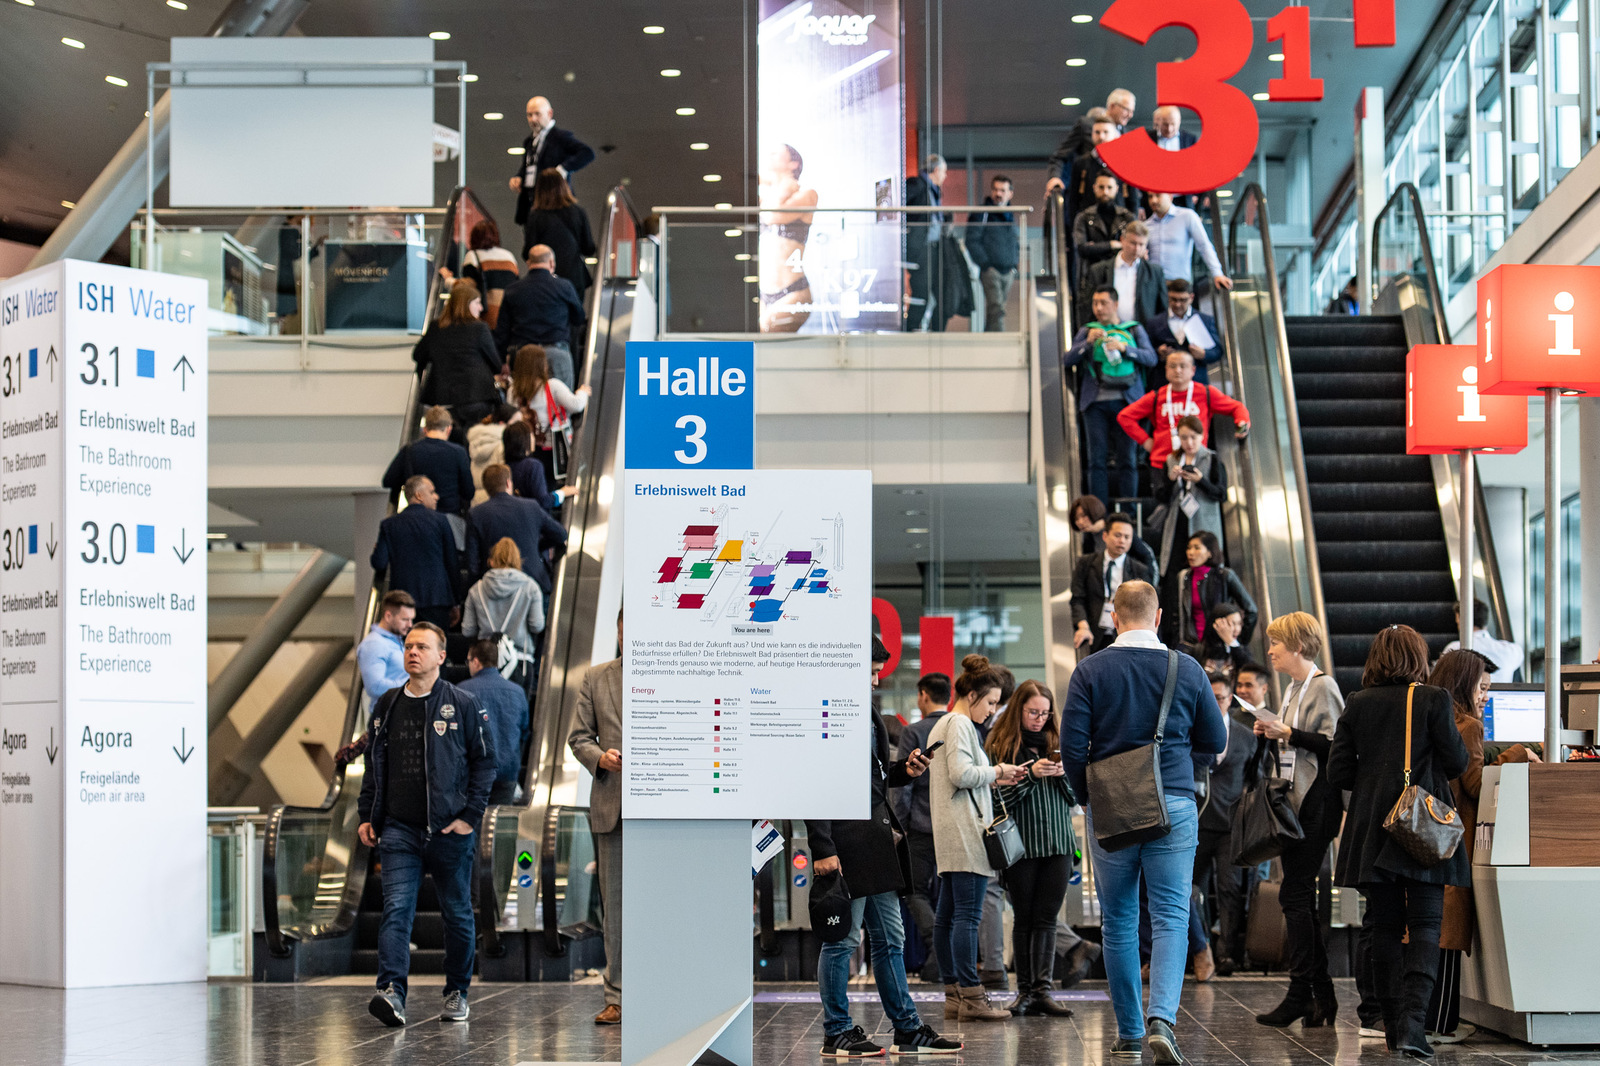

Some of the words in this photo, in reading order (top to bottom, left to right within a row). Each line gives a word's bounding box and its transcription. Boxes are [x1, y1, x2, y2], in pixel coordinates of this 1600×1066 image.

[2, 294, 19, 326] ISH
[25, 288, 58, 318] Water
[78, 282, 114, 313] ISH
[129, 288, 196, 324] Water
[2, 352, 22, 398] 3.1
[79, 342, 120, 388] 3.1
[639, 356, 746, 396] Halle
[2, 414, 44, 439] Erlebniswelt
[44, 412, 58, 429] Bad
[80, 410, 166, 435] Erlebniswelt
[170, 418, 196, 438] Bad
[674, 414, 708, 465] 3
[2, 456, 14, 474] The
[15, 452, 46, 472] Bathroom
[79, 444, 103, 464] The
[108, 448, 172, 470] Bathroom
[2, 482, 36, 502] Experience
[80, 474, 151, 498] Experience
[634, 484, 717, 497] Erlebniswelt
[721, 484, 746, 497] Bad
[2, 526, 25, 571] 3.0
[80, 520, 127, 565] 3.0
[2, 592, 43, 612] Erlebniswelt
[44, 590, 58, 608] Bad
[80, 588, 166, 610] Erlebniswelt
[170, 593, 196, 612] Bad
[2, 630, 13, 648] The
[14, 628, 46, 647] Bathroom
[79, 624, 103, 643] The
[108, 625, 172, 646] Bathroom
[734, 626, 745, 634] You
[80, 653, 152, 674] Experience
[632, 659, 678, 667] Design-Trends
[724, 660, 755, 668] moderne,
[770, 661, 795, 669] heutige
[797, 660, 861, 669] Herausforderungen
[773, 651, 809, 659] präsentiert
[2, 657, 36, 678] Experience
[677, 669, 715, 677] nachhaltige
[632, 687, 655, 695] Energy
[2, 728, 27, 755] Agora
[80, 725, 133, 753] Agora
[80, 770, 140, 788] Freigelände
[80, 789, 106, 806] Open
[108, 789, 122, 802] air
[126, 792, 145, 802] area
